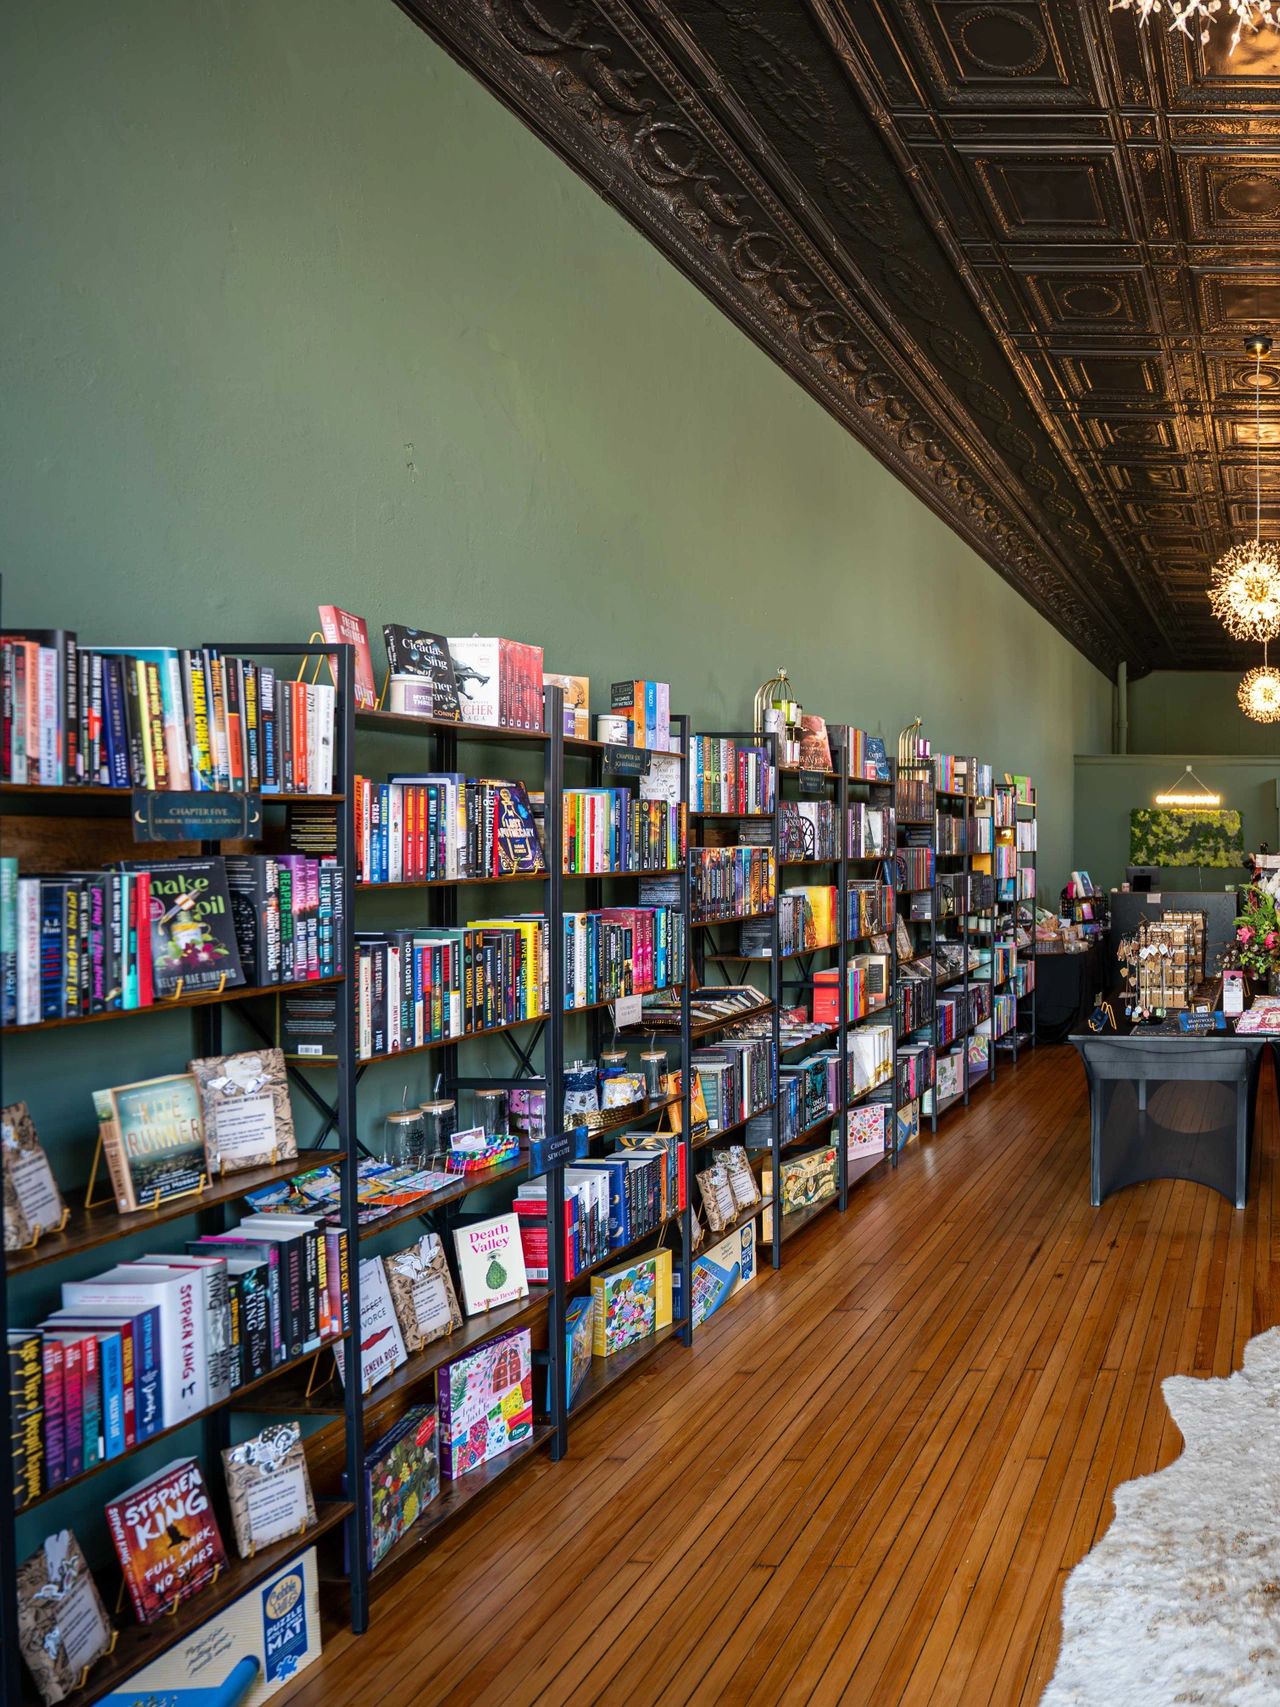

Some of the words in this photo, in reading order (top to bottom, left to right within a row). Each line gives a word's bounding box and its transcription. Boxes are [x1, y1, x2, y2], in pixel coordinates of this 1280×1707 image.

[402, 637, 444, 657] Cicadas
[424, 655, 448, 671] Sing
[191, 671, 204, 714] HARLAN
[261, 673, 273, 712] FLASHPOINT
[169, 807, 208, 817] CHAPTER
[210, 807, 228, 817] FIVE
[372, 804, 380, 824] CRASH
[266, 860, 276, 893] HENDRIX
[321, 873, 331, 888] LISA
[334, 873, 343, 890] LISA
[112, 891, 121, 903] the
[195, 896, 226, 915] oil
[279, 873, 291, 911] REAPER
[296, 881, 307, 906] JANCE
[306, 880, 318, 906] JANCE
[321, 889, 332, 913] JEWELL
[334, 891, 344, 919] JEWELL
[267, 907, 277, 945] HAUNTED
[297, 921, 307, 932] DEN
[306, 918, 317, 931] DEN
[112, 938, 122, 953] love
[267, 945, 277, 971] HOUSE
[297, 941, 308, 969] INIQUITY
[307, 936, 318, 965] INIQUITY
[466, 968, 474, 1009] HOMICIDE
[476, 966, 484, 1006] HOMICIDE
[126, 1117, 203, 1157] RUNNER
[550, 1139, 569, 1150] CHARM
[317, 1235, 326, 1255] CLIVE
[469, 1224, 509, 1244] Death
[472, 1237, 509, 1256] Valley
[206, 1270, 223, 1312] KING
[273, 1269, 281, 1291] LOCAL
[256, 1284, 267, 1331] STEPHEN
[273, 1293, 281, 1319] WOMAN
[308, 1286, 316, 1309] ELLERY
[178, 1284, 193, 1341] STEPHEN
[231, 1298, 239, 1328] STEPHEN
[244, 1294, 258, 1332] KING
[309, 1310, 317, 1331] LLOYD
[361, 1307, 387, 1328] VORCE
[143, 1313, 153, 1348] STEPHEN
[232, 1328, 240, 1345] KING
[145, 1349, 153, 1370] KING
[181, 1343, 196, 1380] KING
[251, 1333, 262, 1366] STAND
[206, 1354, 220, 1389] FLINCH
[45, 1373, 63, 1416] FIRST
[67, 1373, 81, 1410] FIRST
[46, 1420, 64, 1468] LIGHT
[67, 1411, 82, 1450] LIGHT
[125, 1467, 204, 1528] STEPHEN
[133, 1489, 210, 1553] KING
[144, 1557, 176, 1583] FULL
[179, 1526, 217, 1559] DARK,
[155, 1576, 176, 1599] NO
[178, 1542, 214, 1578] STARS
[266, 1604, 303, 1637] PUZZLE
[267, 1617, 305, 1656] MAT
